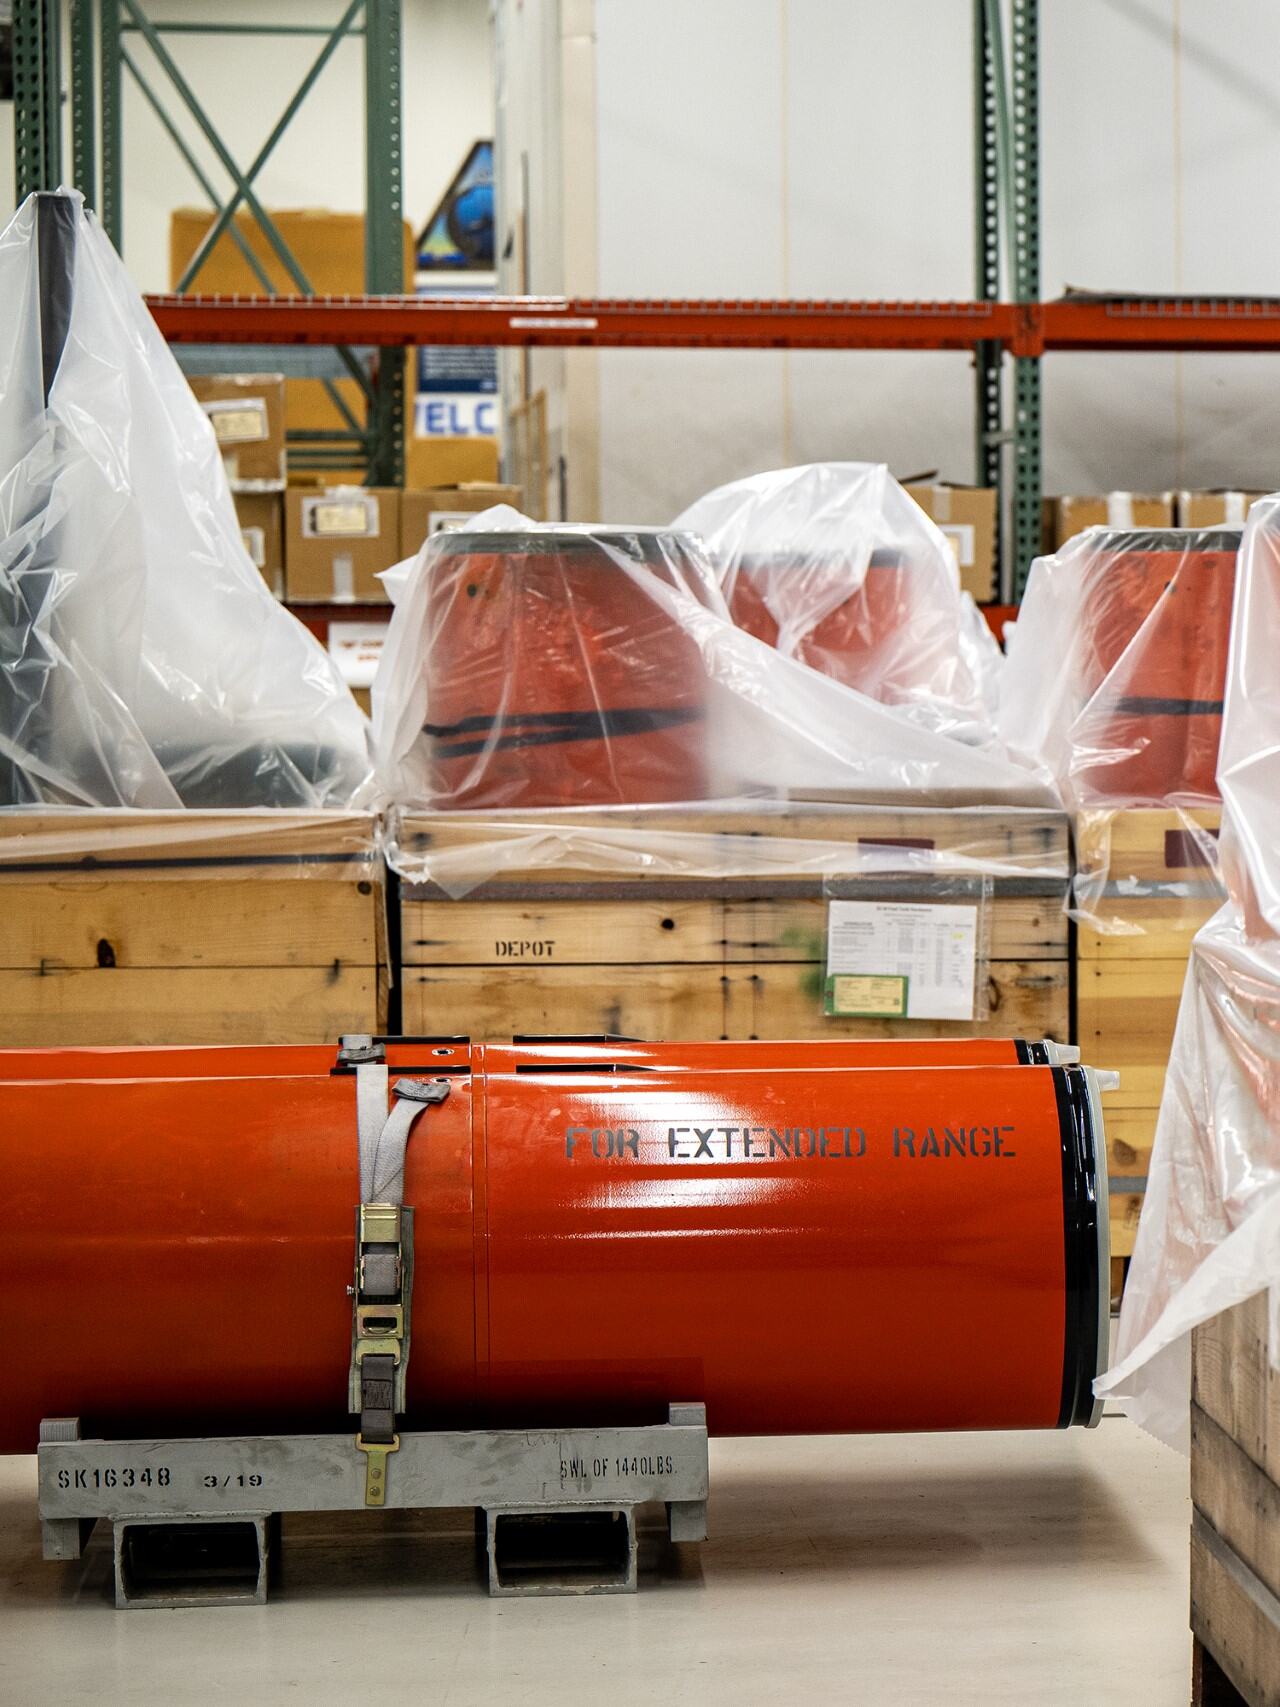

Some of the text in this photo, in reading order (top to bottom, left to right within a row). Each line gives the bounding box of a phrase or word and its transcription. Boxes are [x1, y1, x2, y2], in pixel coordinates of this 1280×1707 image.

[415, 402, 495, 434] ELC
[495, 940, 556, 957] DEPOT
[564, 1127, 1017, 1159] FOR EXTENDED RANGE
[58, 1467, 171, 1489] SK16348
[560, 1457, 588, 1478] SWL
[593, 1457, 609, 1477] OF
[203, 1474, 263, 1488] 3/19
